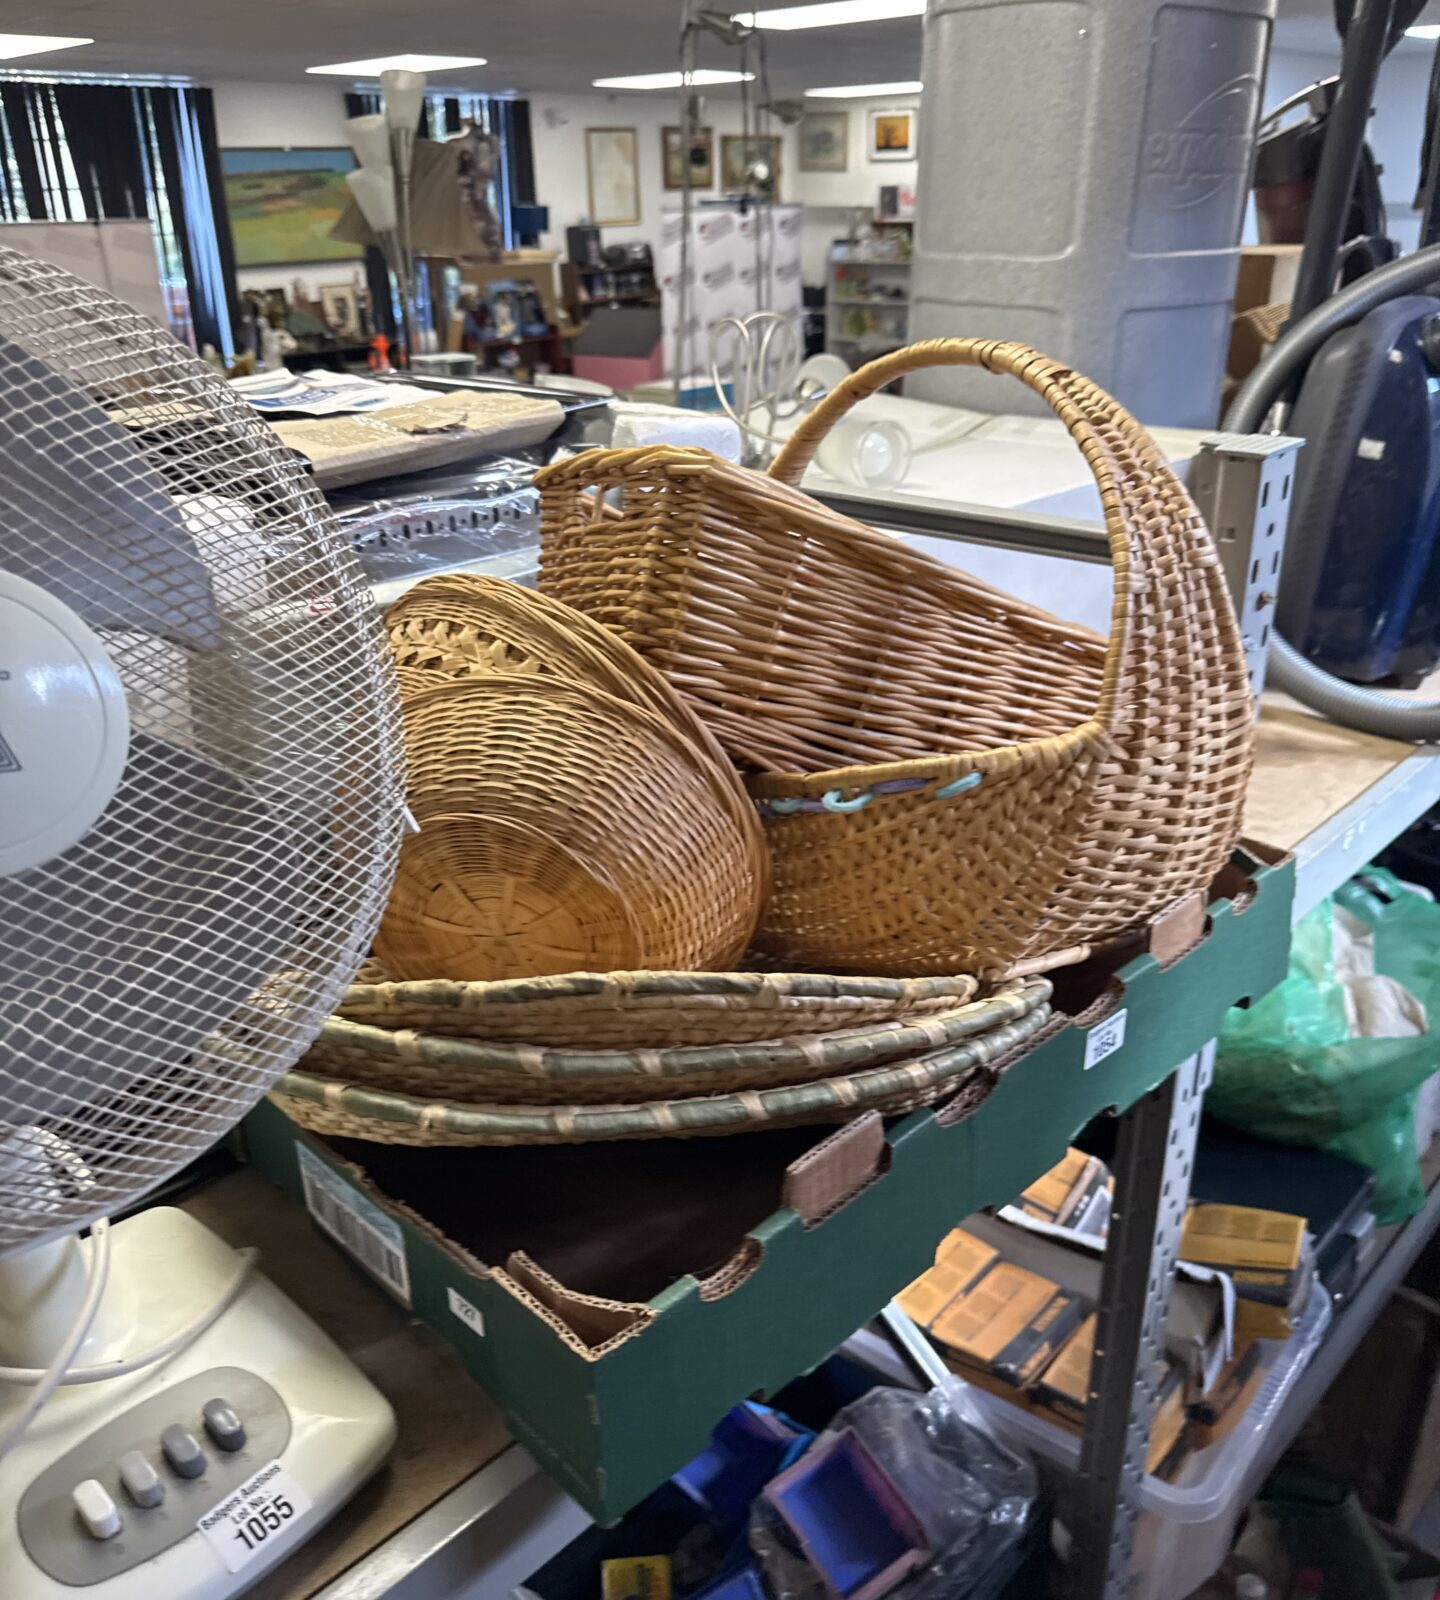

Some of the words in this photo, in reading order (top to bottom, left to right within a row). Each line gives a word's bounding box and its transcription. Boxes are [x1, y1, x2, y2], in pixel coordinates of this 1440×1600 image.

[201, 1496, 242, 1530] Badgers
[241, 1465, 282, 1498] Auctions
[231, 1507, 250, 1525] Lot
[234, 1494, 294, 1549] 1055
